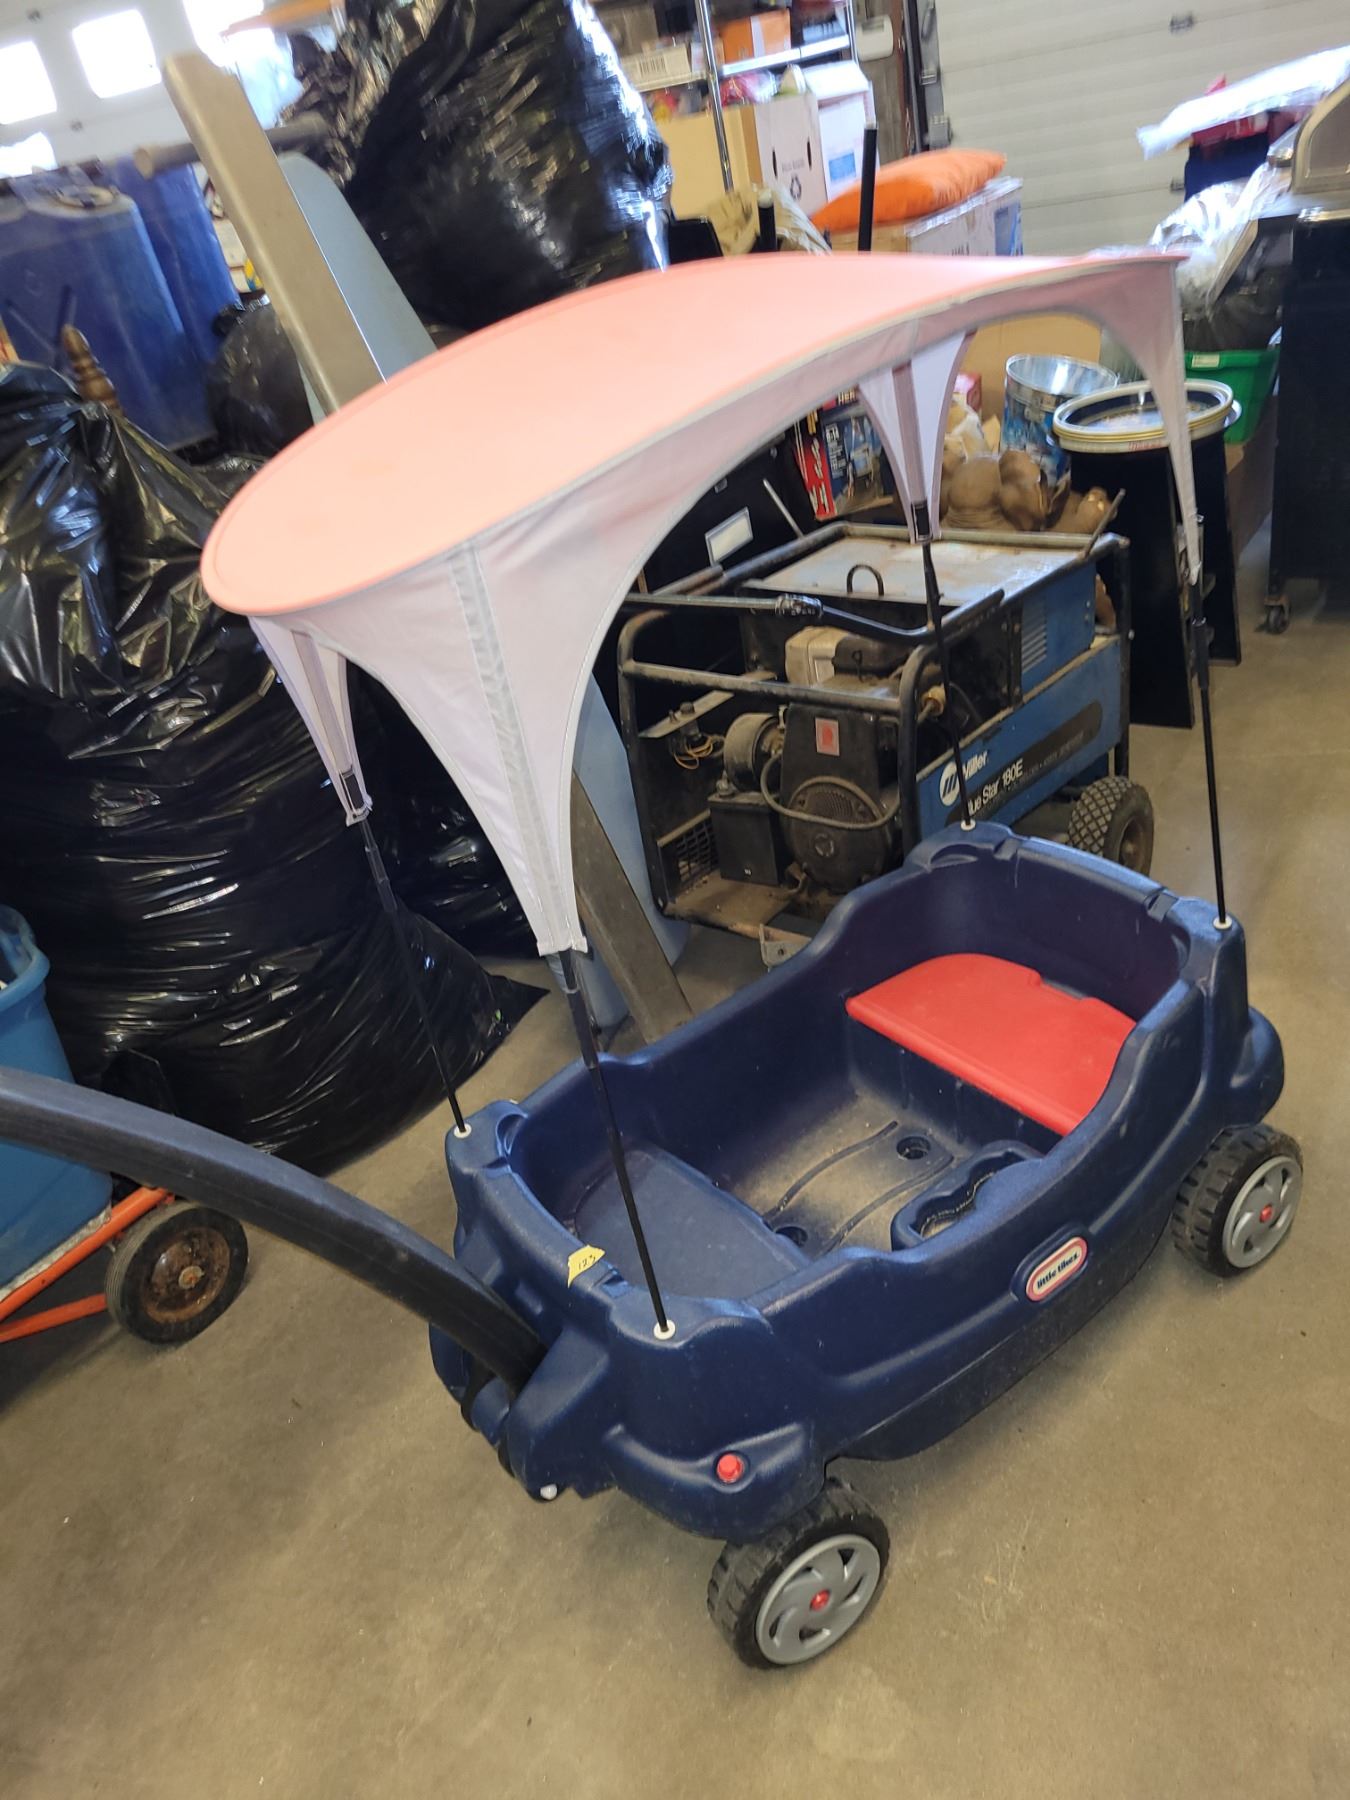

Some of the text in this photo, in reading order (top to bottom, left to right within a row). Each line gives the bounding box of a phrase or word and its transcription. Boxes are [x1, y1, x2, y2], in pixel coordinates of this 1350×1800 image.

[967, 795, 982, 817] lue
[982, 778, 1001, 805] Star
[1002, 758, 1023, 787] 180E
[1037, 1270, 1057, 1289] little
